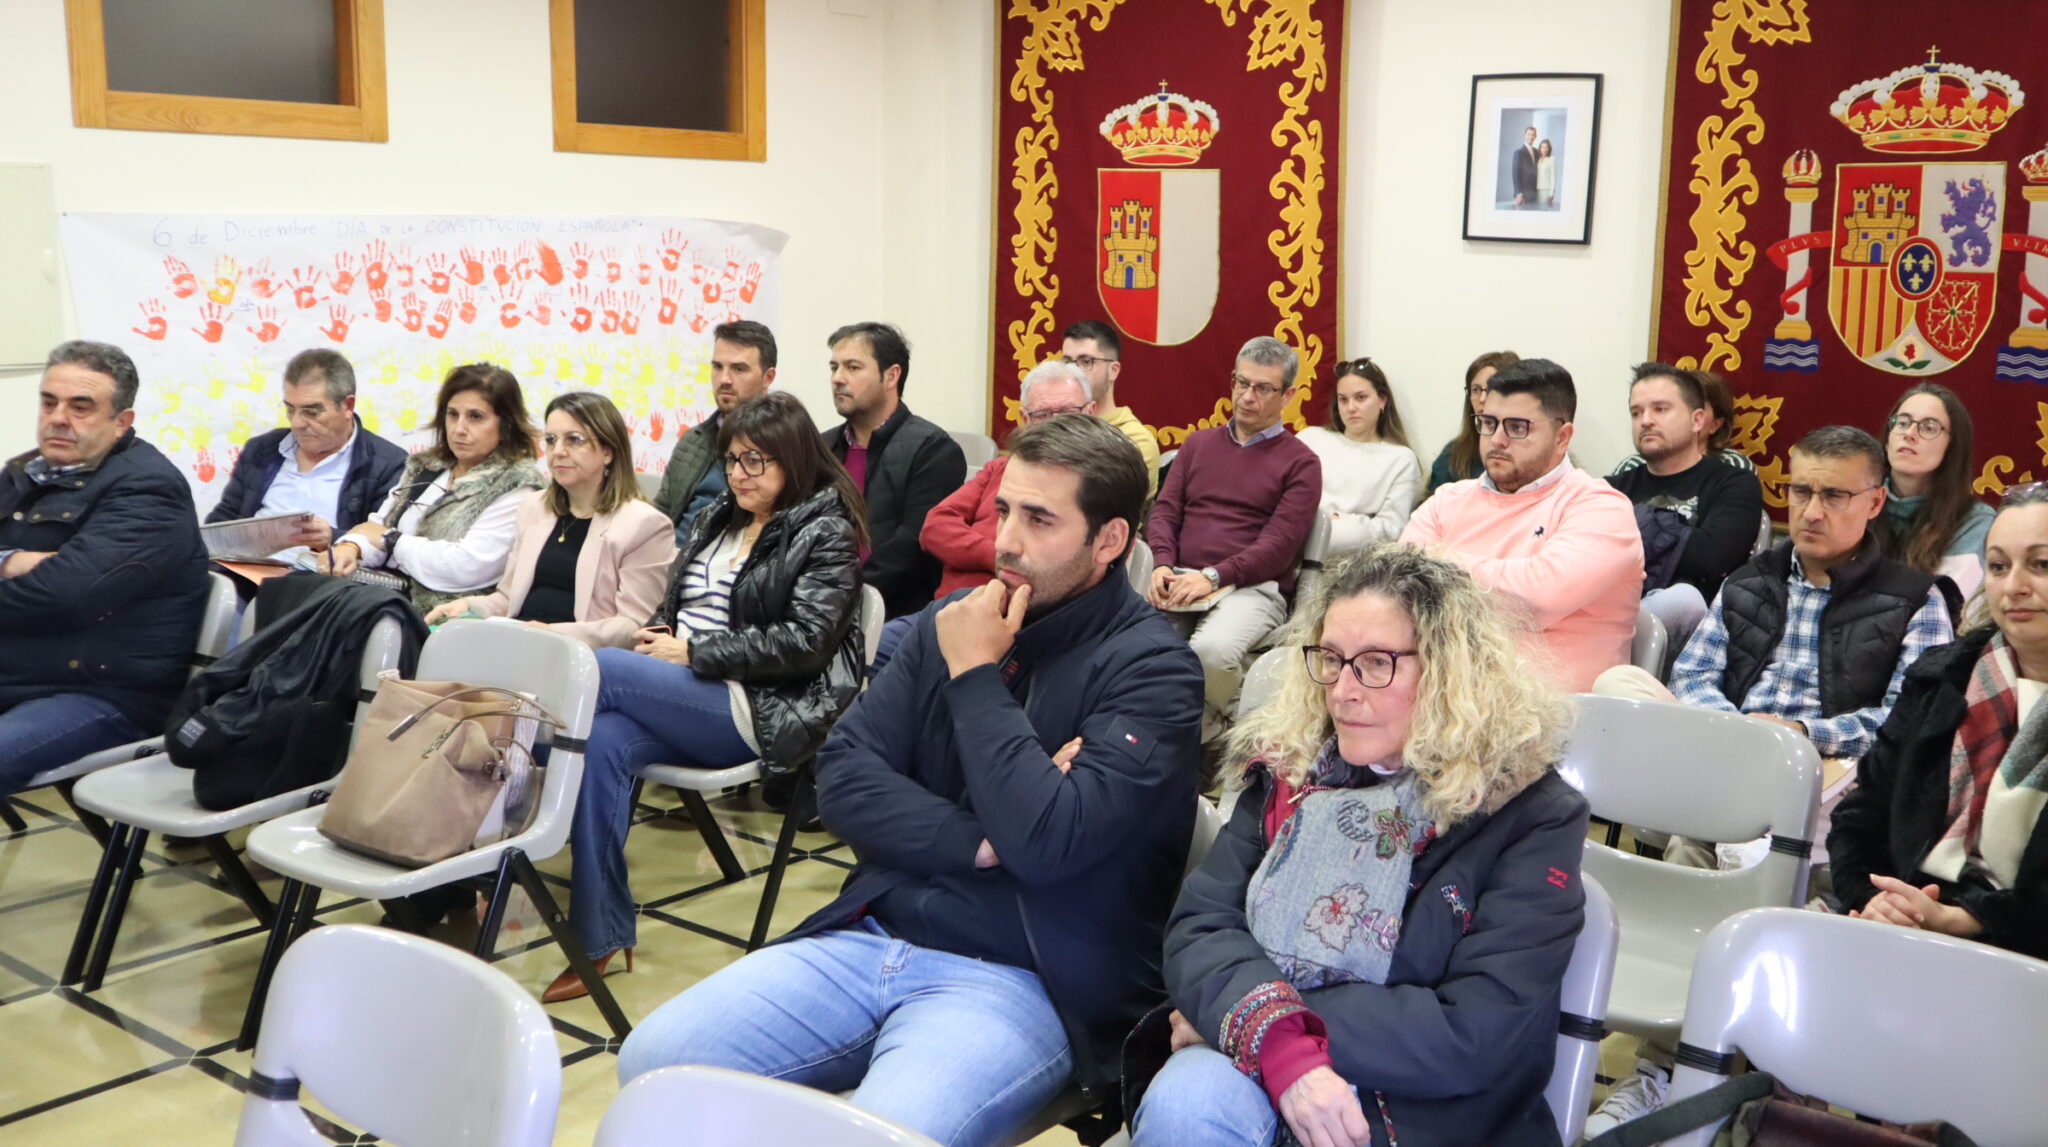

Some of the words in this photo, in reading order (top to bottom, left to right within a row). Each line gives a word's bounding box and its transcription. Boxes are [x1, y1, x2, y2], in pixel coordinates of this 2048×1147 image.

[152, 216, 173, 248] 6
[188, 223, 209, 246] de
[224, 217, 321, 242] Diciembre
[381, 225, 396, 237] DE
[402, 225, 420, 237] LA
[1778, 235, 1822, 254] PLVS
